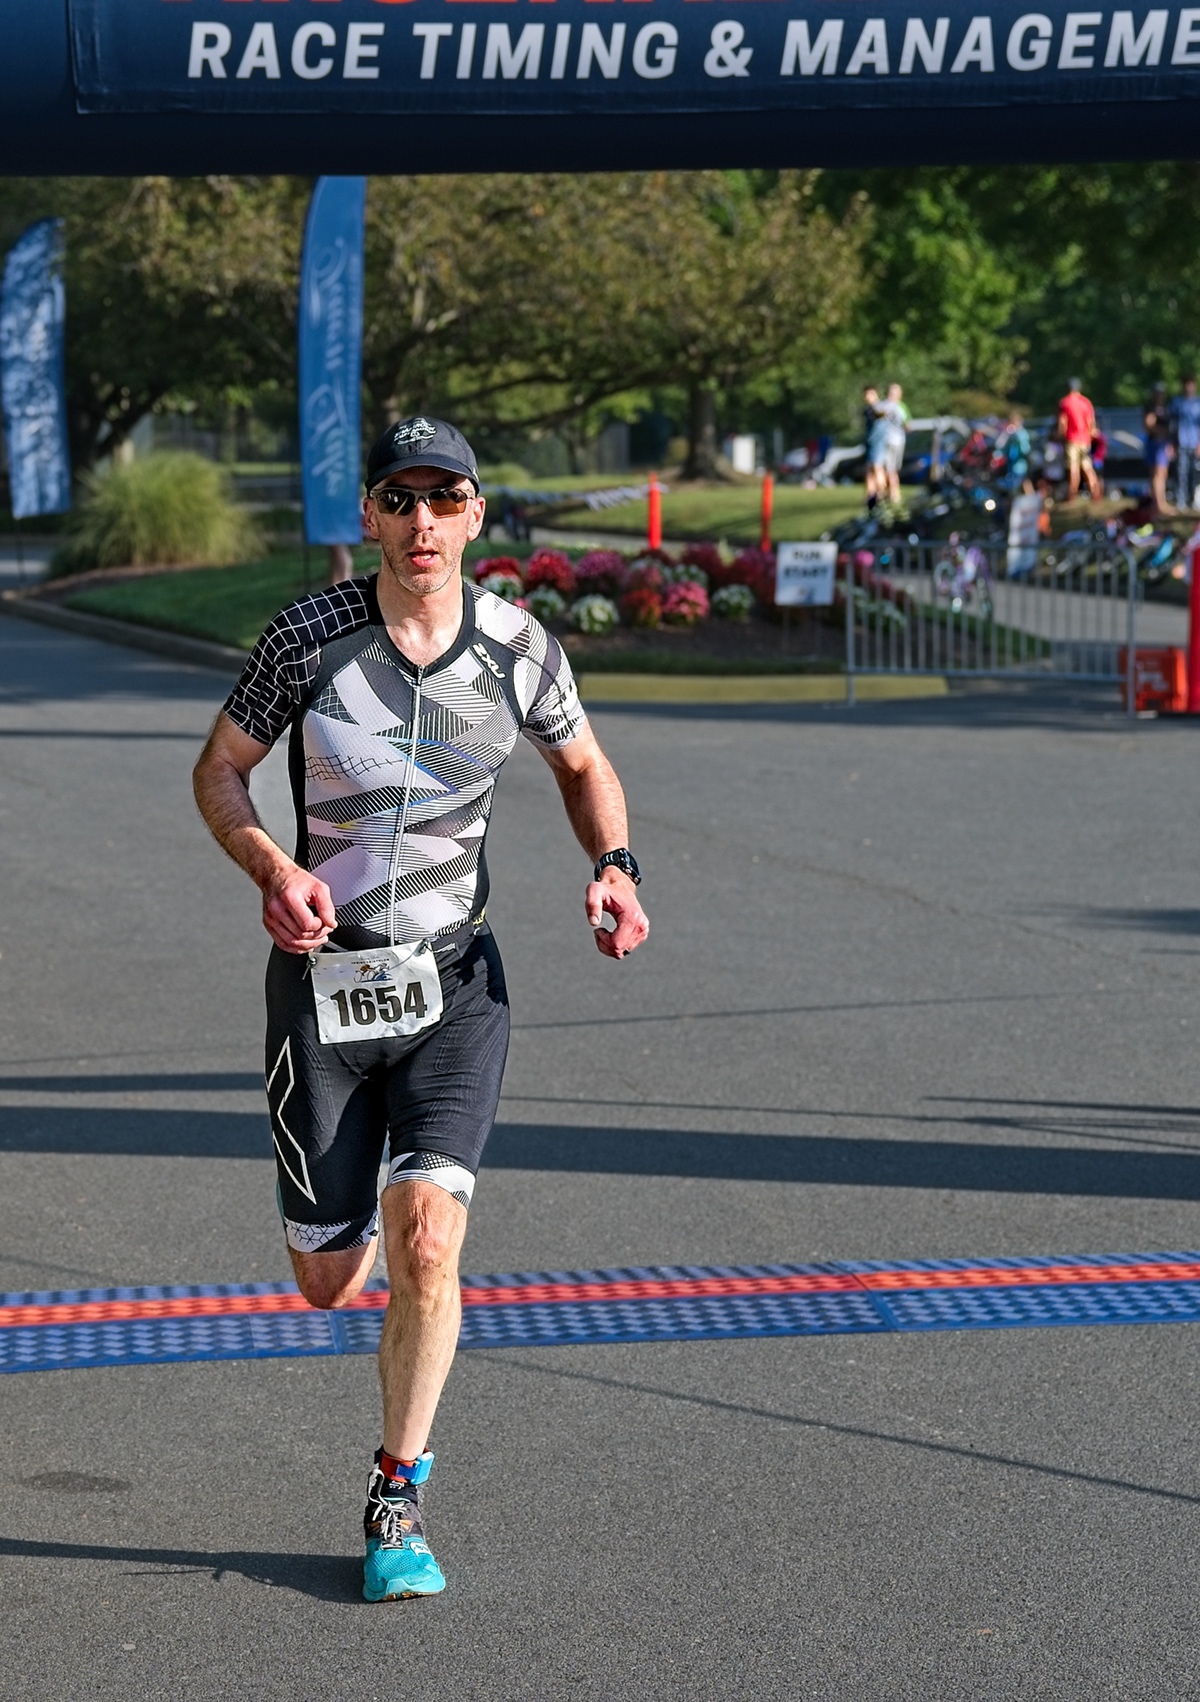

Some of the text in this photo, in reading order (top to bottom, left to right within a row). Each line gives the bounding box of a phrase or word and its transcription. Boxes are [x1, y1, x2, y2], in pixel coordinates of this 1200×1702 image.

[188, 7, 1200, 79] RACE TIMING & MANAGEME
[329, 981, 428, 1028] 1654
